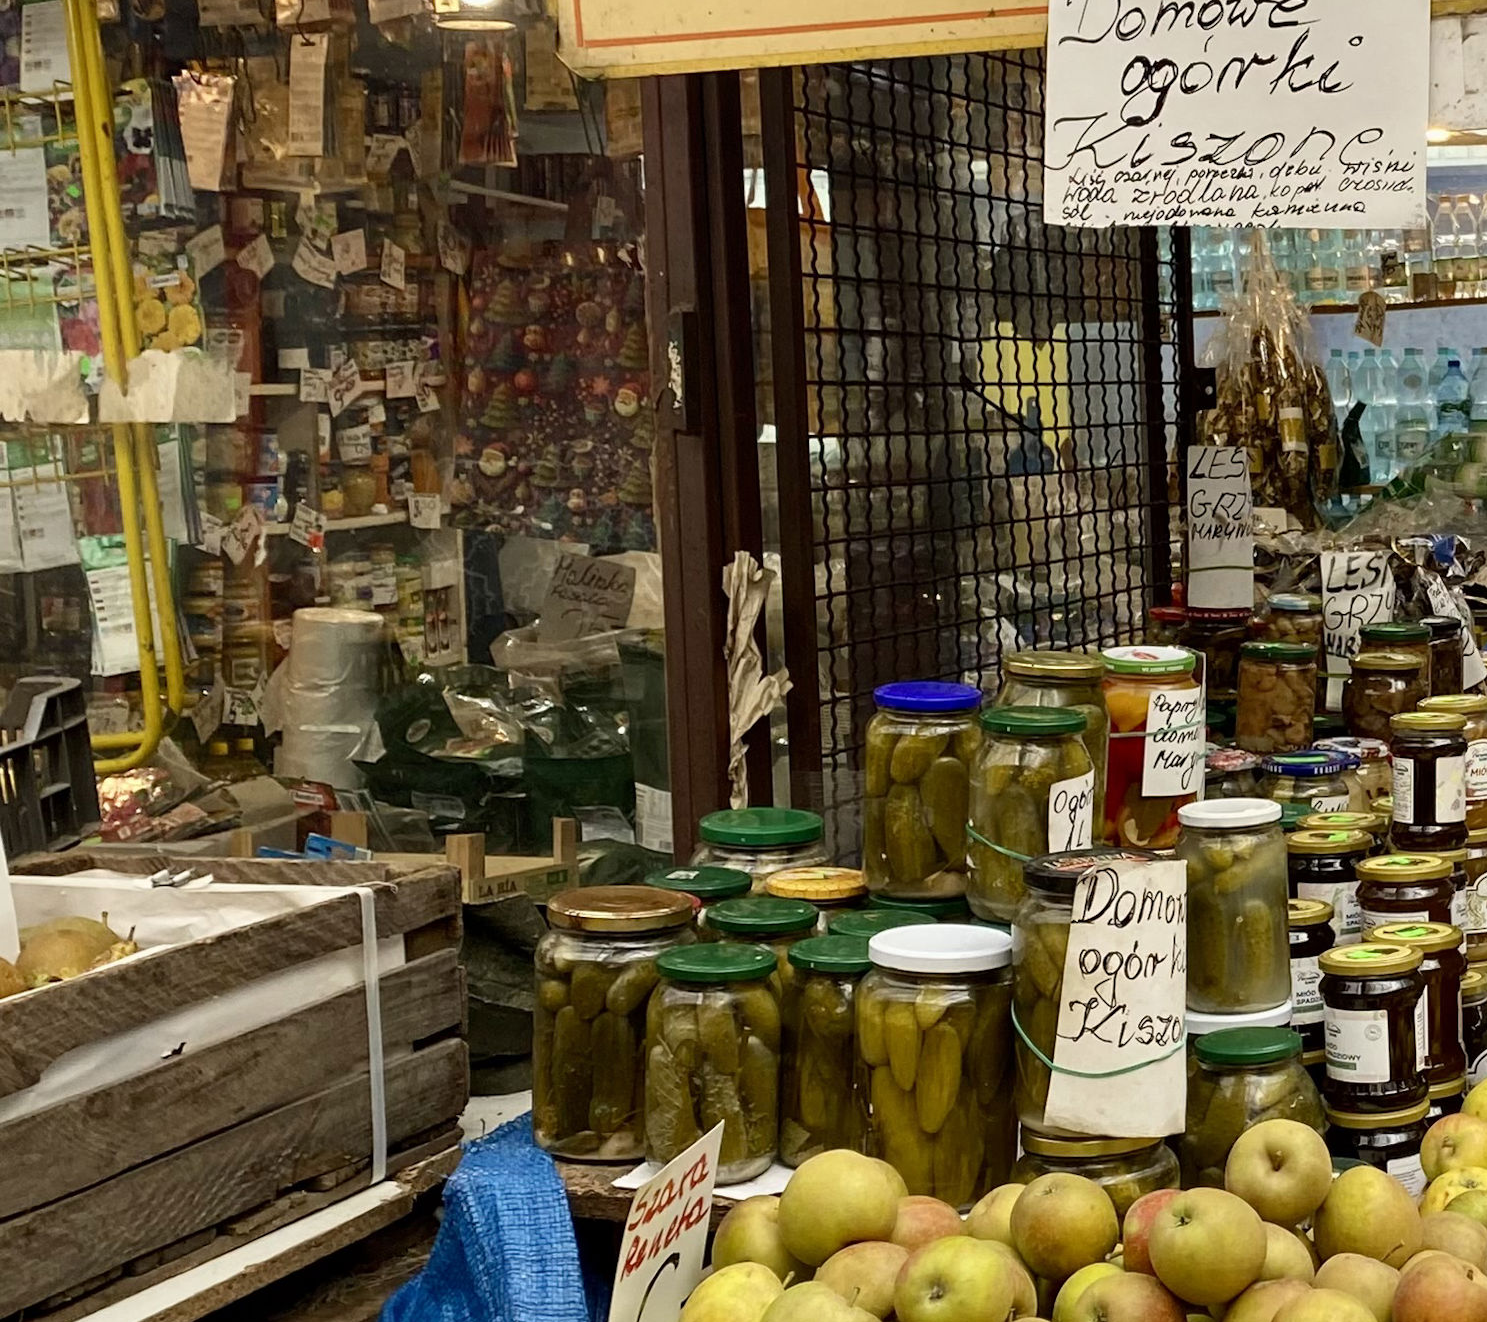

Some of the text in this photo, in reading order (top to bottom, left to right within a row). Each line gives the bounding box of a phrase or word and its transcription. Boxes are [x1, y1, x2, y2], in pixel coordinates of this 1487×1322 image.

[1120, 28, 1364, 126] ogórki
[627, 1151, 711, 1233] Szara
[620, 1195, 711, 1283] Reneta
